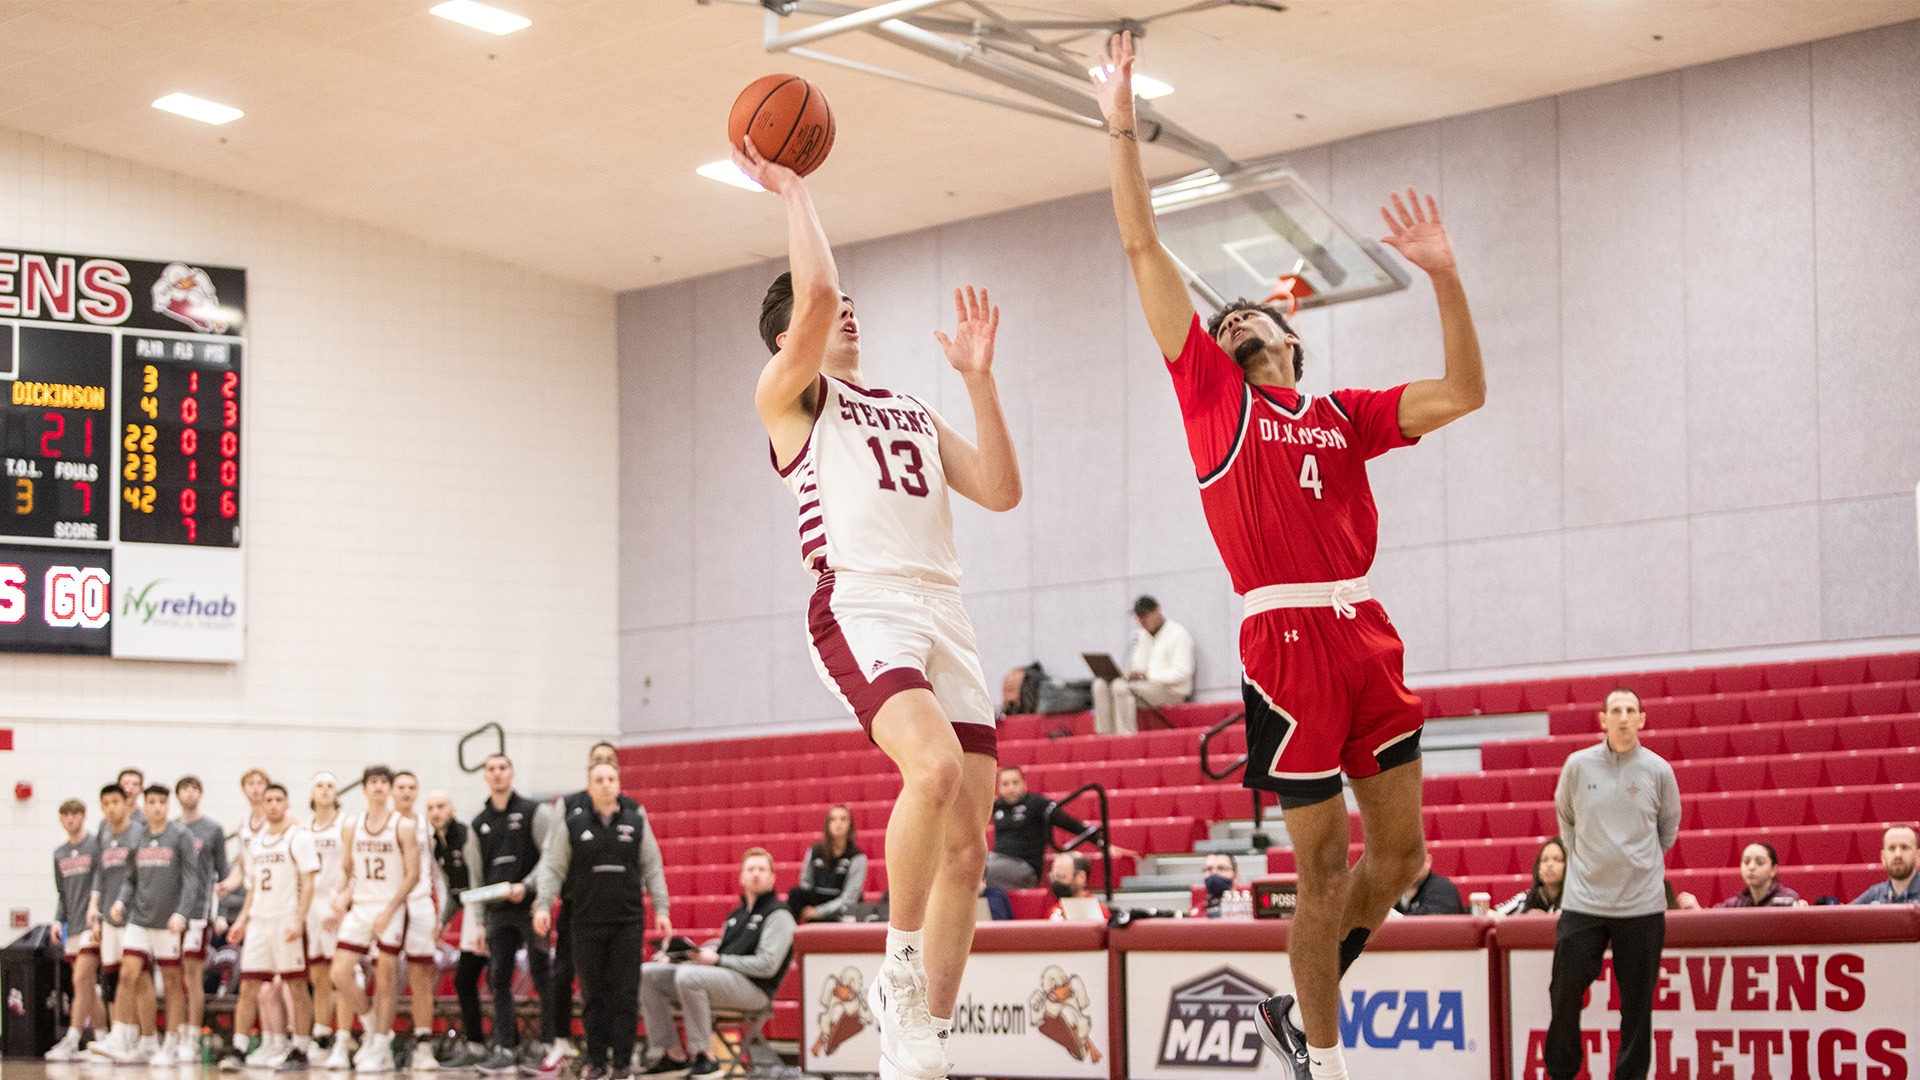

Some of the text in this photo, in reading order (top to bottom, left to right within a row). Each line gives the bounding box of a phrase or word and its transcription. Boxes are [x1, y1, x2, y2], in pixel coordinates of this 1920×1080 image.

[12, 380, 105, 411] DICKINSON
[143, 364, 238, 399] 3 1 2
[140, 396, 238, 428] 4 0 3
[838, 393, 934, 437] STEVENS
[40, 413, 93, 457] 21
[124, 424, 238, 458] 22 0 0
[1259, 418, 1347, 450] DIKNSON
[54, 461, 99, 482] FOULS
[124, 453, 238, 487] 23 1 0
[867, 436, 930, 497] 13
[1299, 453, 1323, 500] 4
[16, 478, 92, 515] 3 7
[123, 485, 238, 518] 42 0 6
[54, 521, 98, 541] SCORE
[182, 517, 198, 541] 7
[261, 868, 272, 891] 2
[365, 858, 386, 880] 12
[1582, 953, 1866, 1012] TEVENS
[1339, 990, 1465, 1050] NCAA
[1164, 1018, 1260, 1062] MAC
